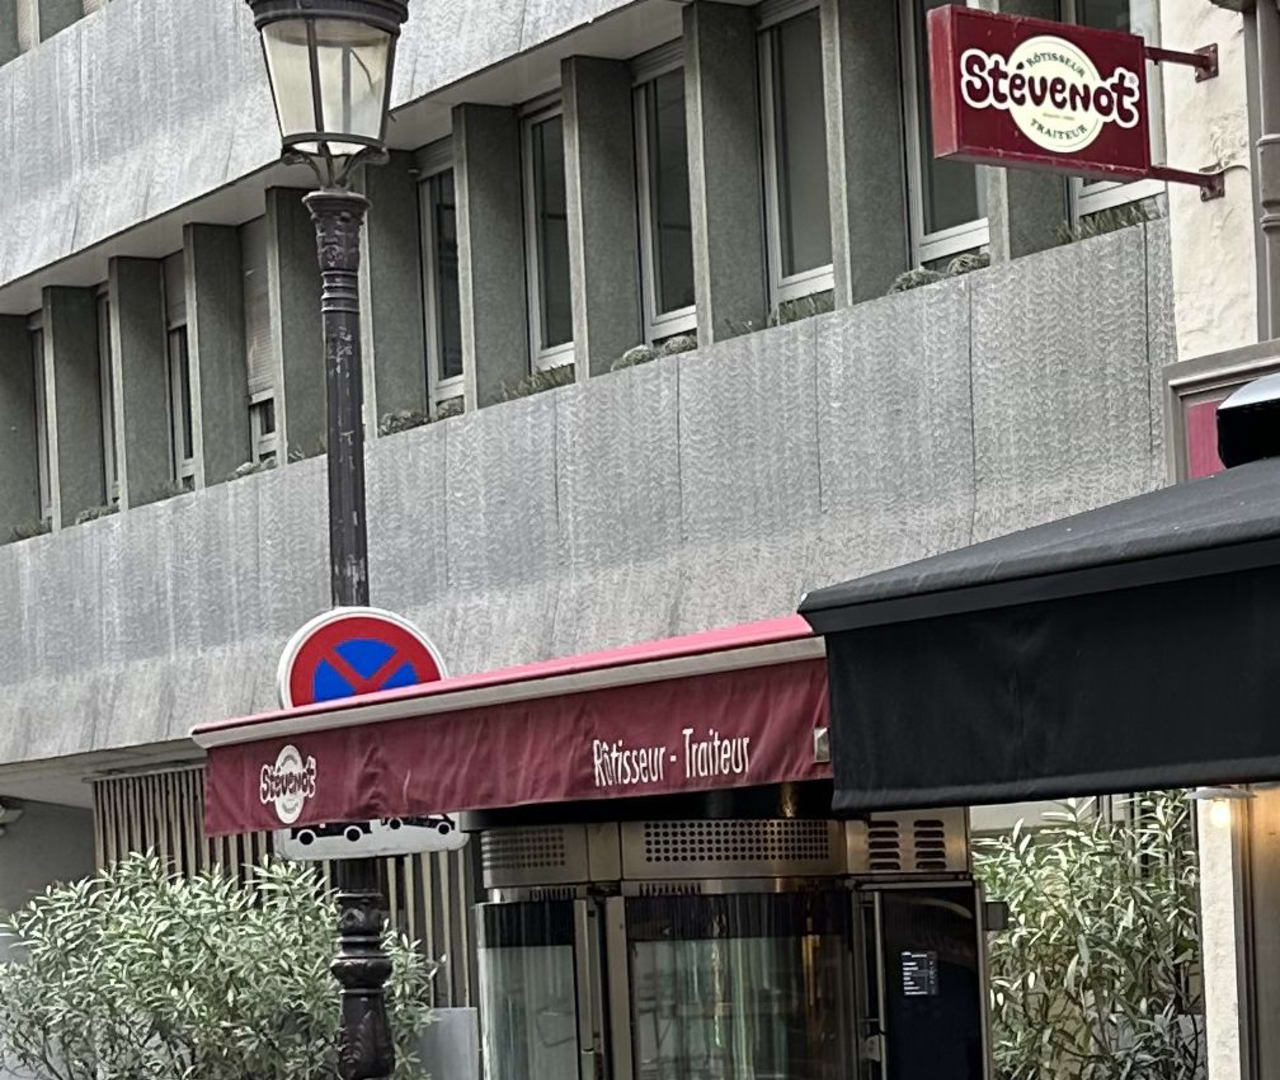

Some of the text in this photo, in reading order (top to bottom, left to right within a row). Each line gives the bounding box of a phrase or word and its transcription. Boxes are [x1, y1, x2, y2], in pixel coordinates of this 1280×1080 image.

[1026, 51, 1086, 78] RÔTISSEUR
[965, 53, 1136, 124] Stévenot
[1030, 118, 1088, 140] TRAITEUR
[592, 739, 666, 787] Rôtisseur
[682, 728, 750, 779] Traiteur
